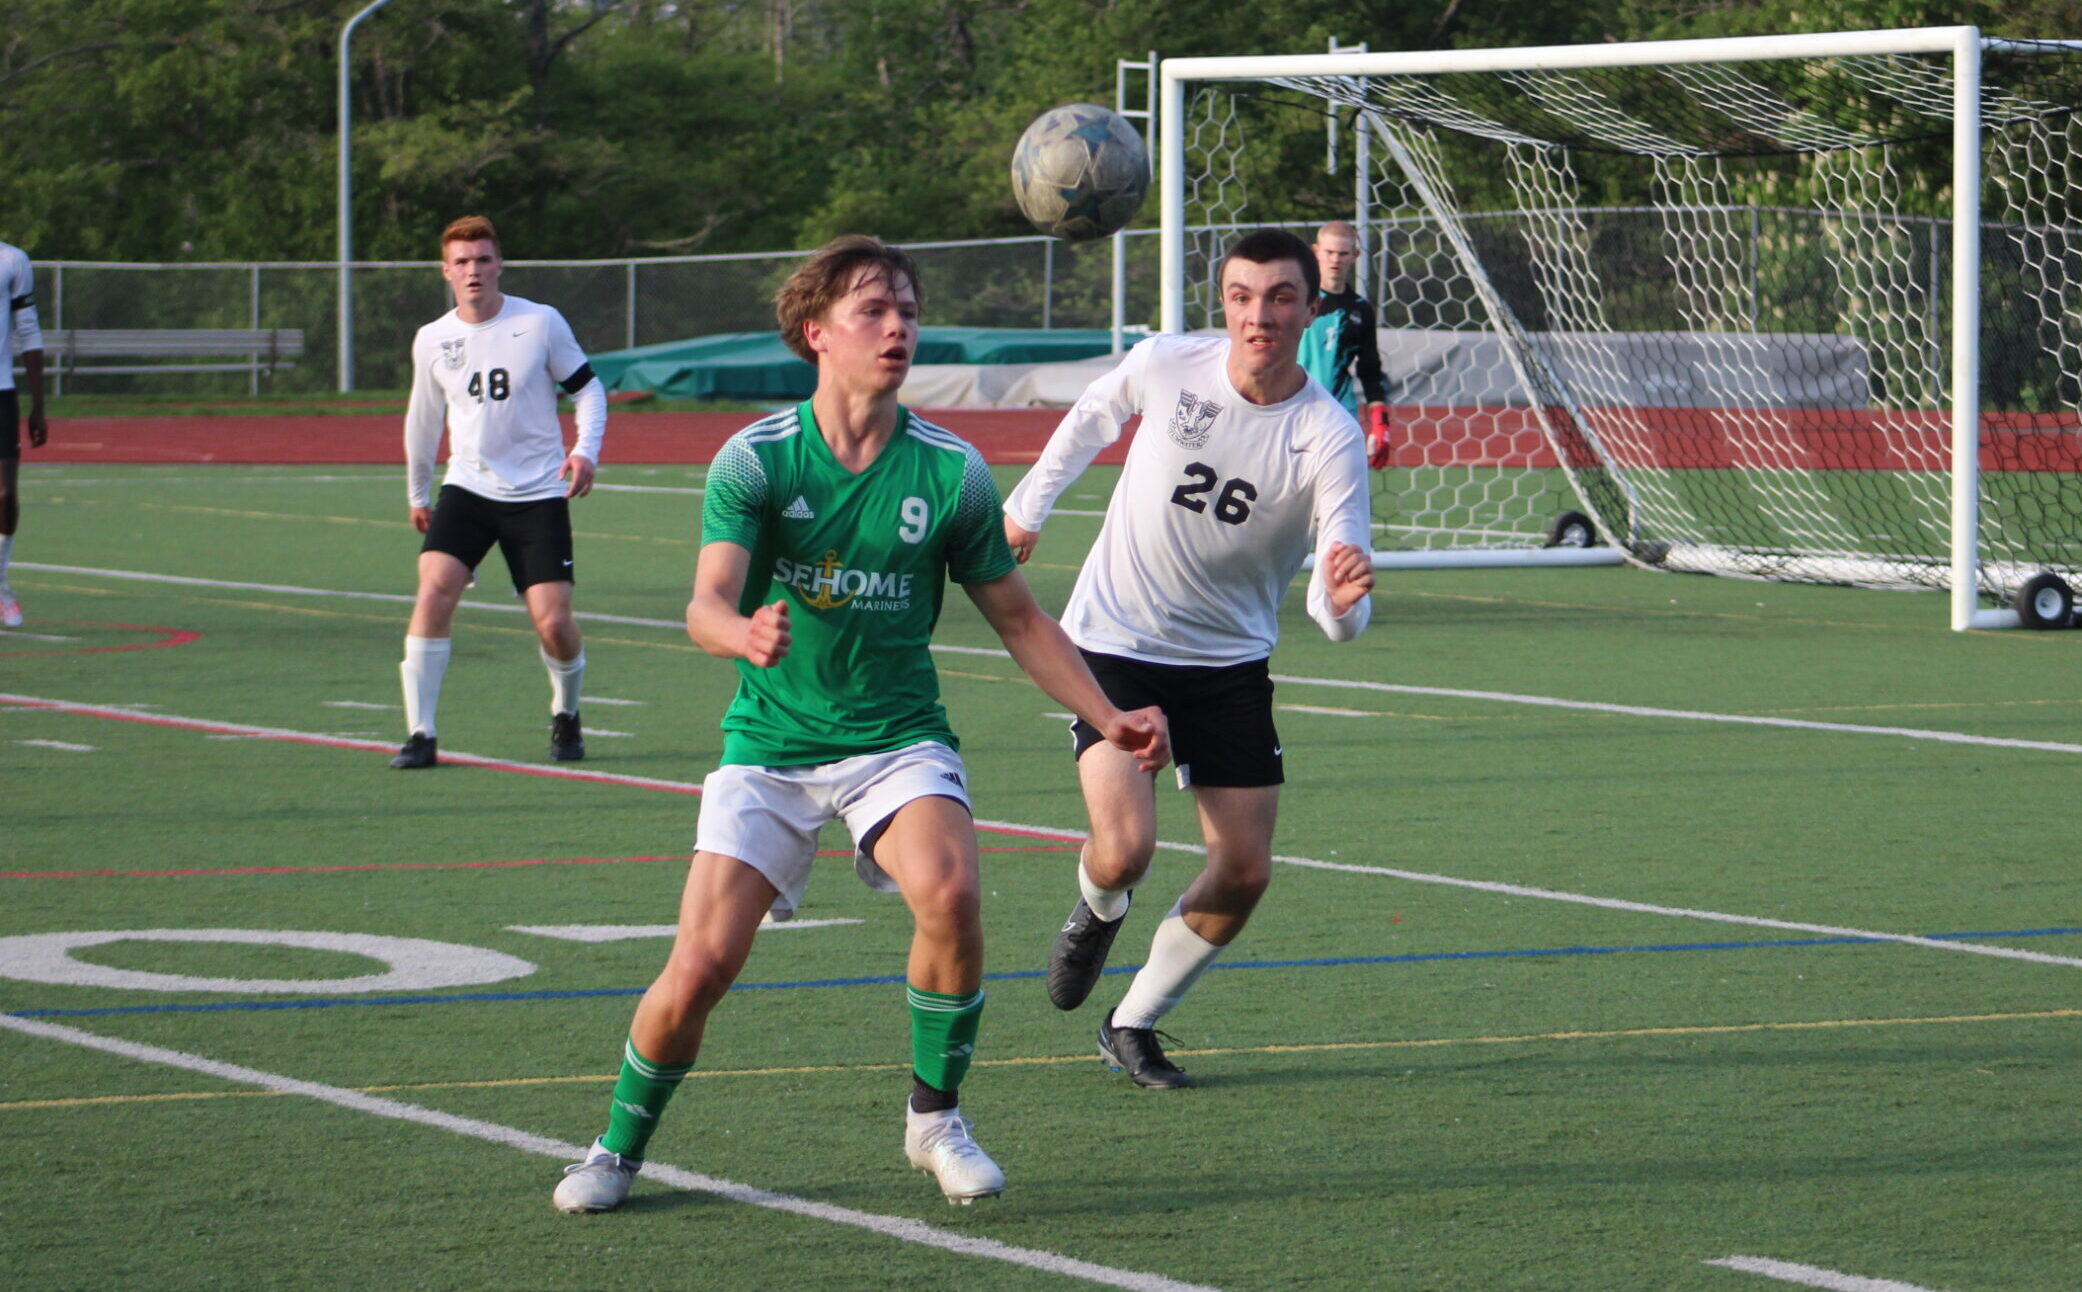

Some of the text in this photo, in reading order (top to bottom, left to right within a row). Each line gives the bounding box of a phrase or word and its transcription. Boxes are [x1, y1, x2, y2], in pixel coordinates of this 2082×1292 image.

[468, 367, 511, 404] 48
[781, 509, 815, 519] adidas
[1170, 461, 1258, 526] 26
[898, 496, 929, 544] 9
[772, 557, 914, 599] SEHOME
